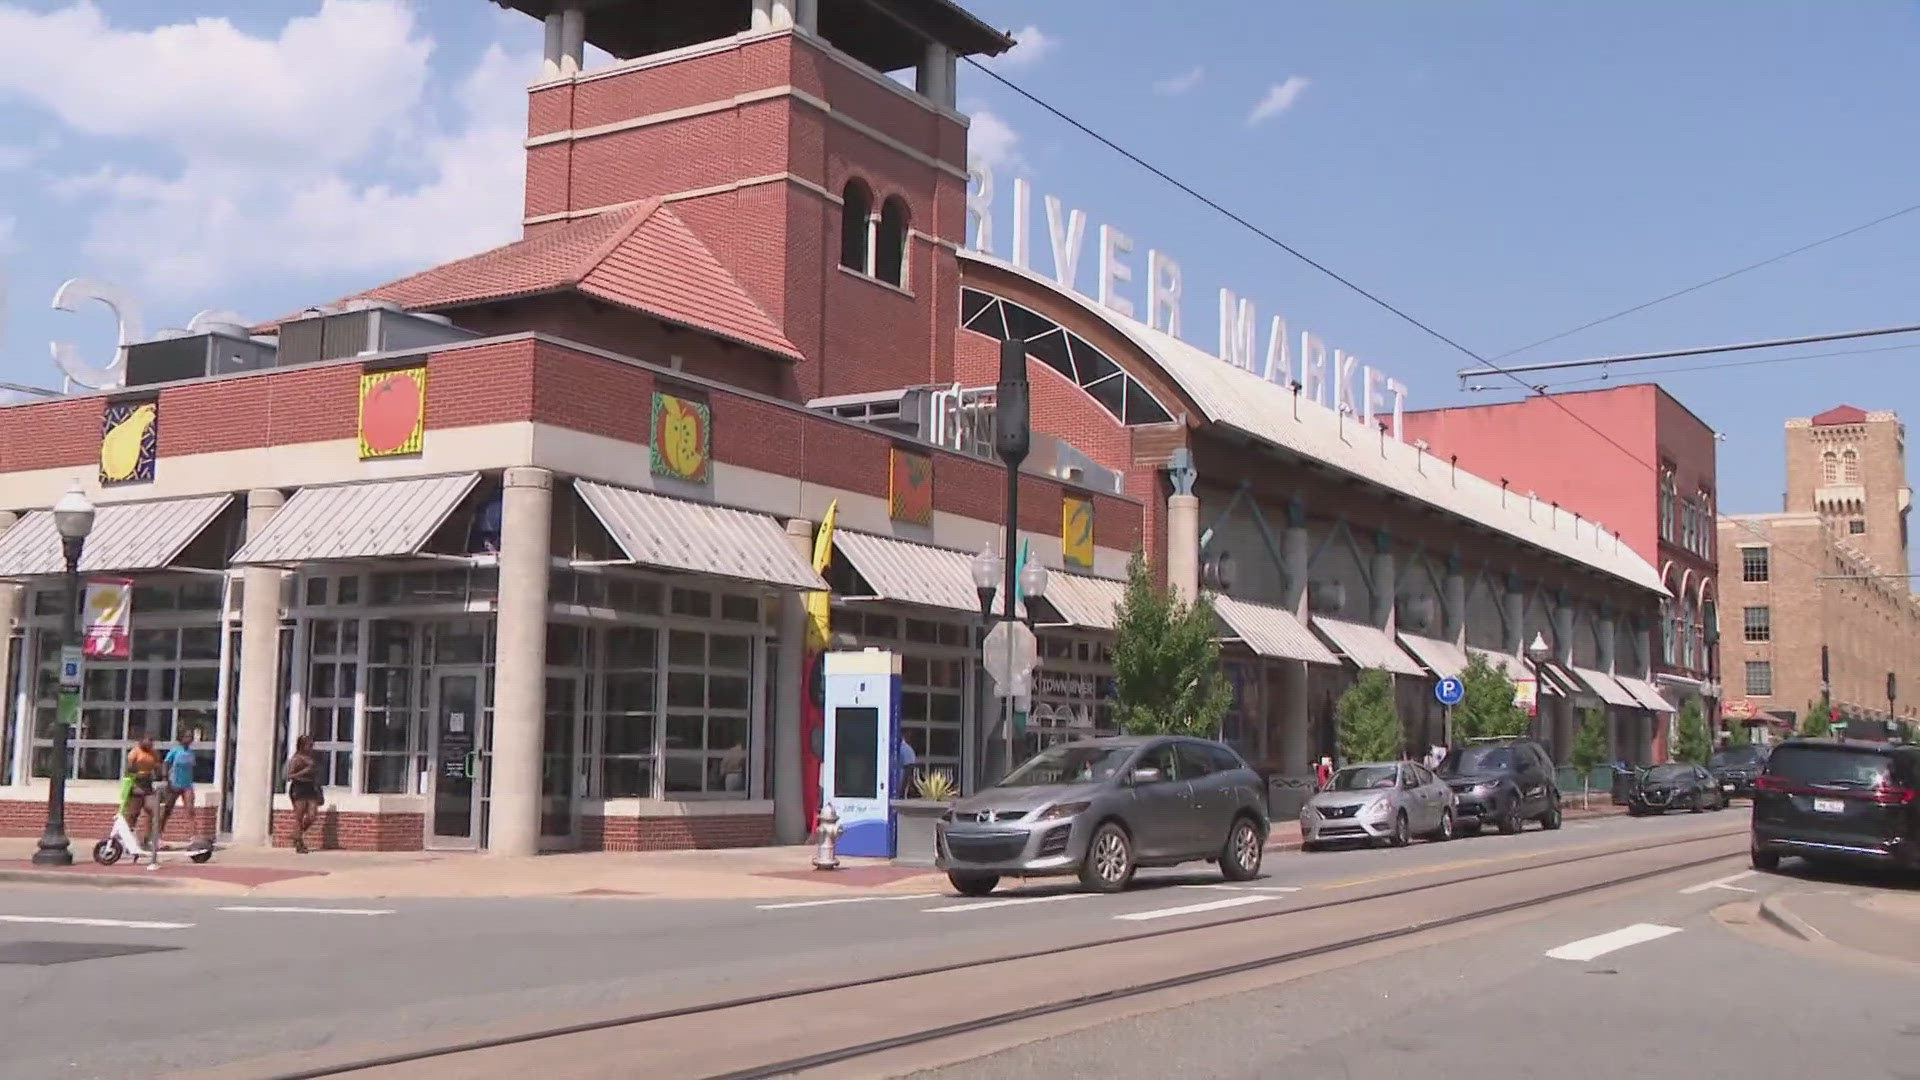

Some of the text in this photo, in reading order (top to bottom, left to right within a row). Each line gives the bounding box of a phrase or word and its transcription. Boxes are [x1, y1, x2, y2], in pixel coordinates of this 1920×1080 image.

[967, 163, 1408, 443] RIVER MARKET
[1443, 681, 1455, 696] P
